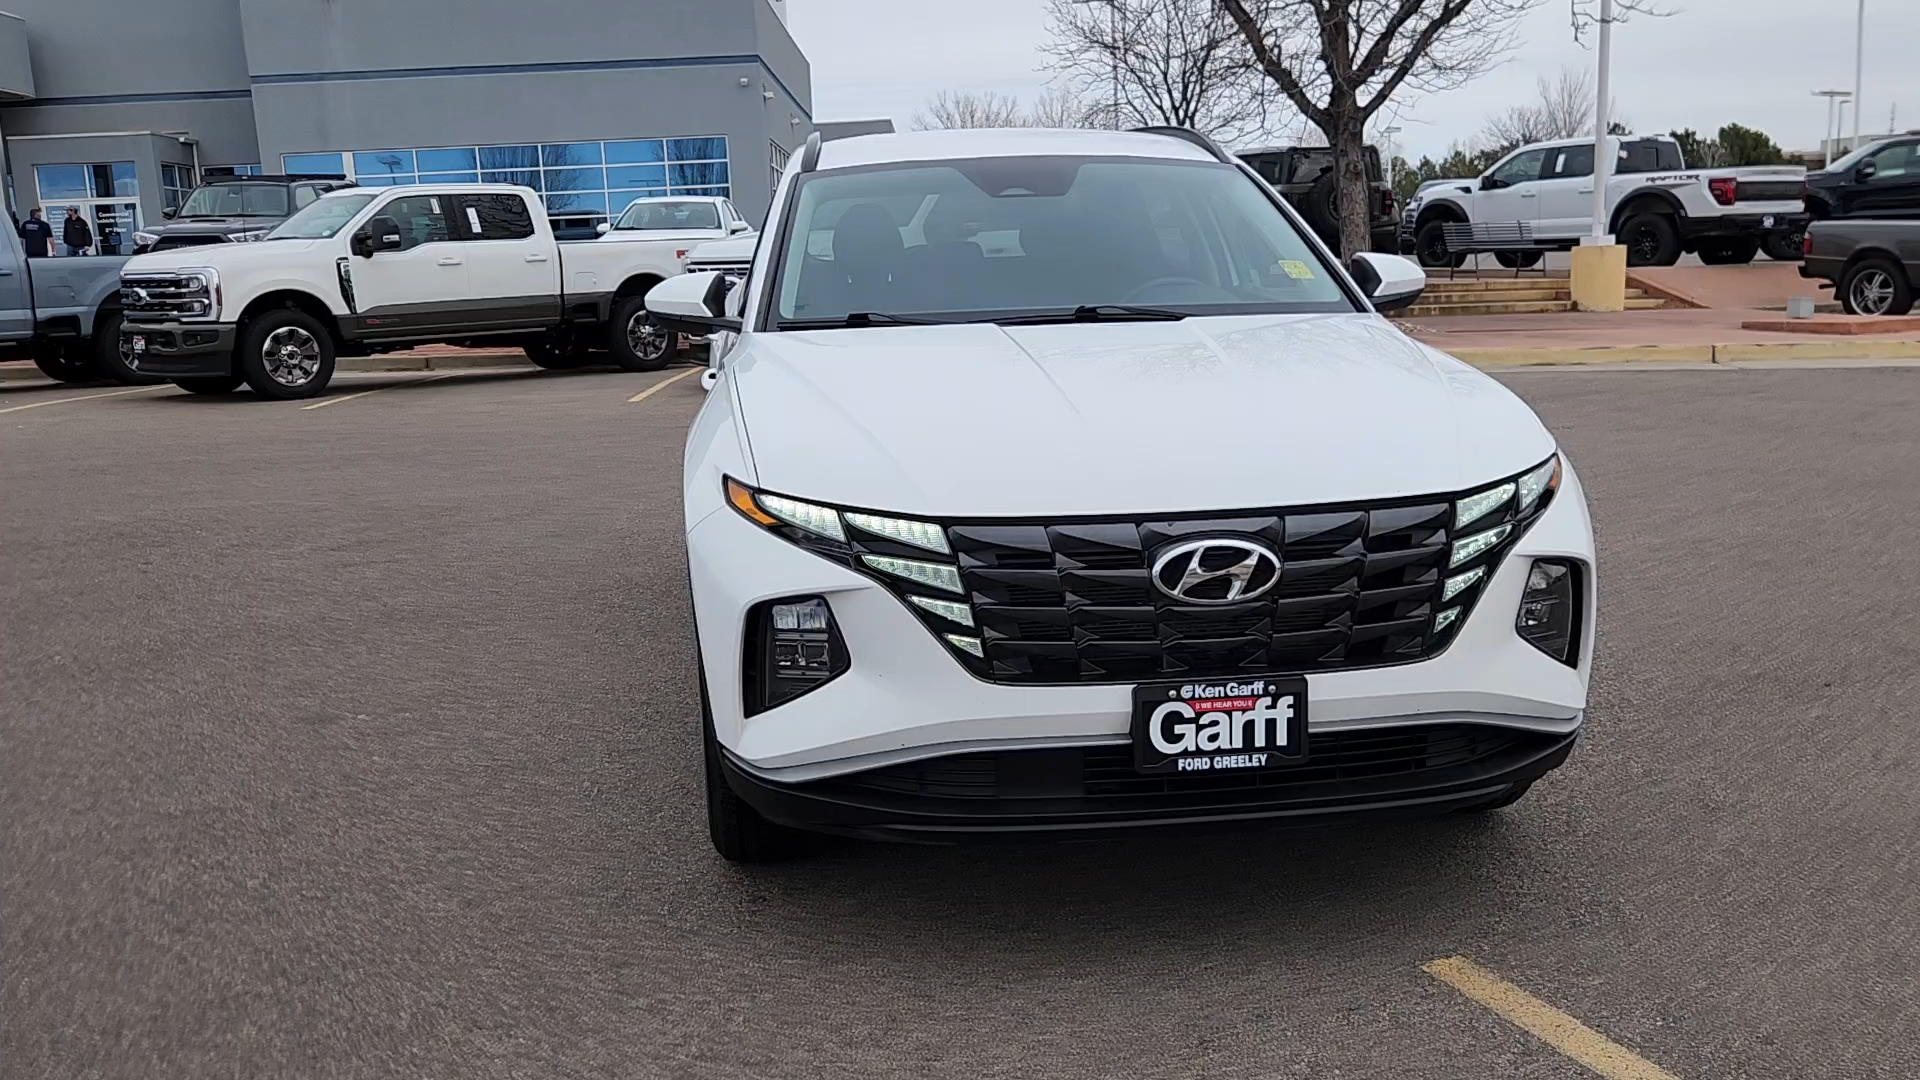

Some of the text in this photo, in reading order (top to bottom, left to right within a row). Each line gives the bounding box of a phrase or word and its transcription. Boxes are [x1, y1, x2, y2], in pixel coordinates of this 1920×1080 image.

[1646, 175, 1702, 184] RAPTOR
[1194, 681, 1265, 698] Ken Garff
[1232, 700, 1249, 708] YOU
[1149, 695, 1294, 755] Garff
[1178, 753, 1268, 771] FORD GREELEY
